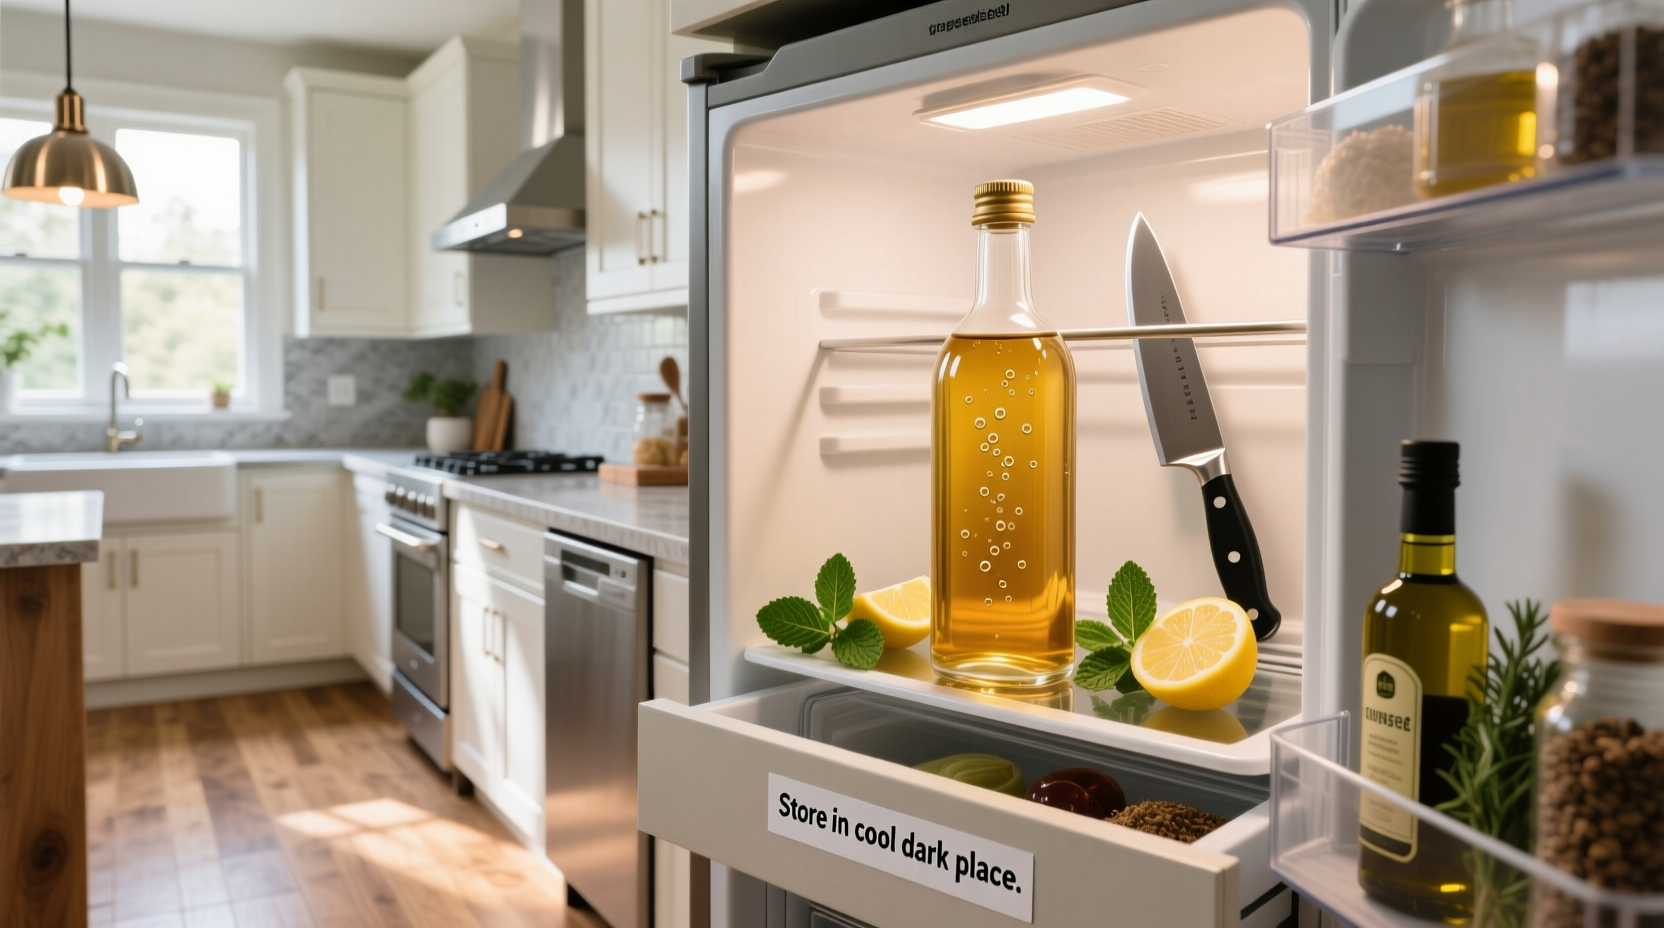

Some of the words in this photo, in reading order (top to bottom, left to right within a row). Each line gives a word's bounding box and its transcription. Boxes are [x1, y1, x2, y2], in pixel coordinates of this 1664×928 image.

[778, 792, 828, 829] Store
[831, 806, 849, 837] in
[854, 822, 897, 853] cool
[901, 831, 950, 871] dark
[955, 850, 1022, 894] place.
